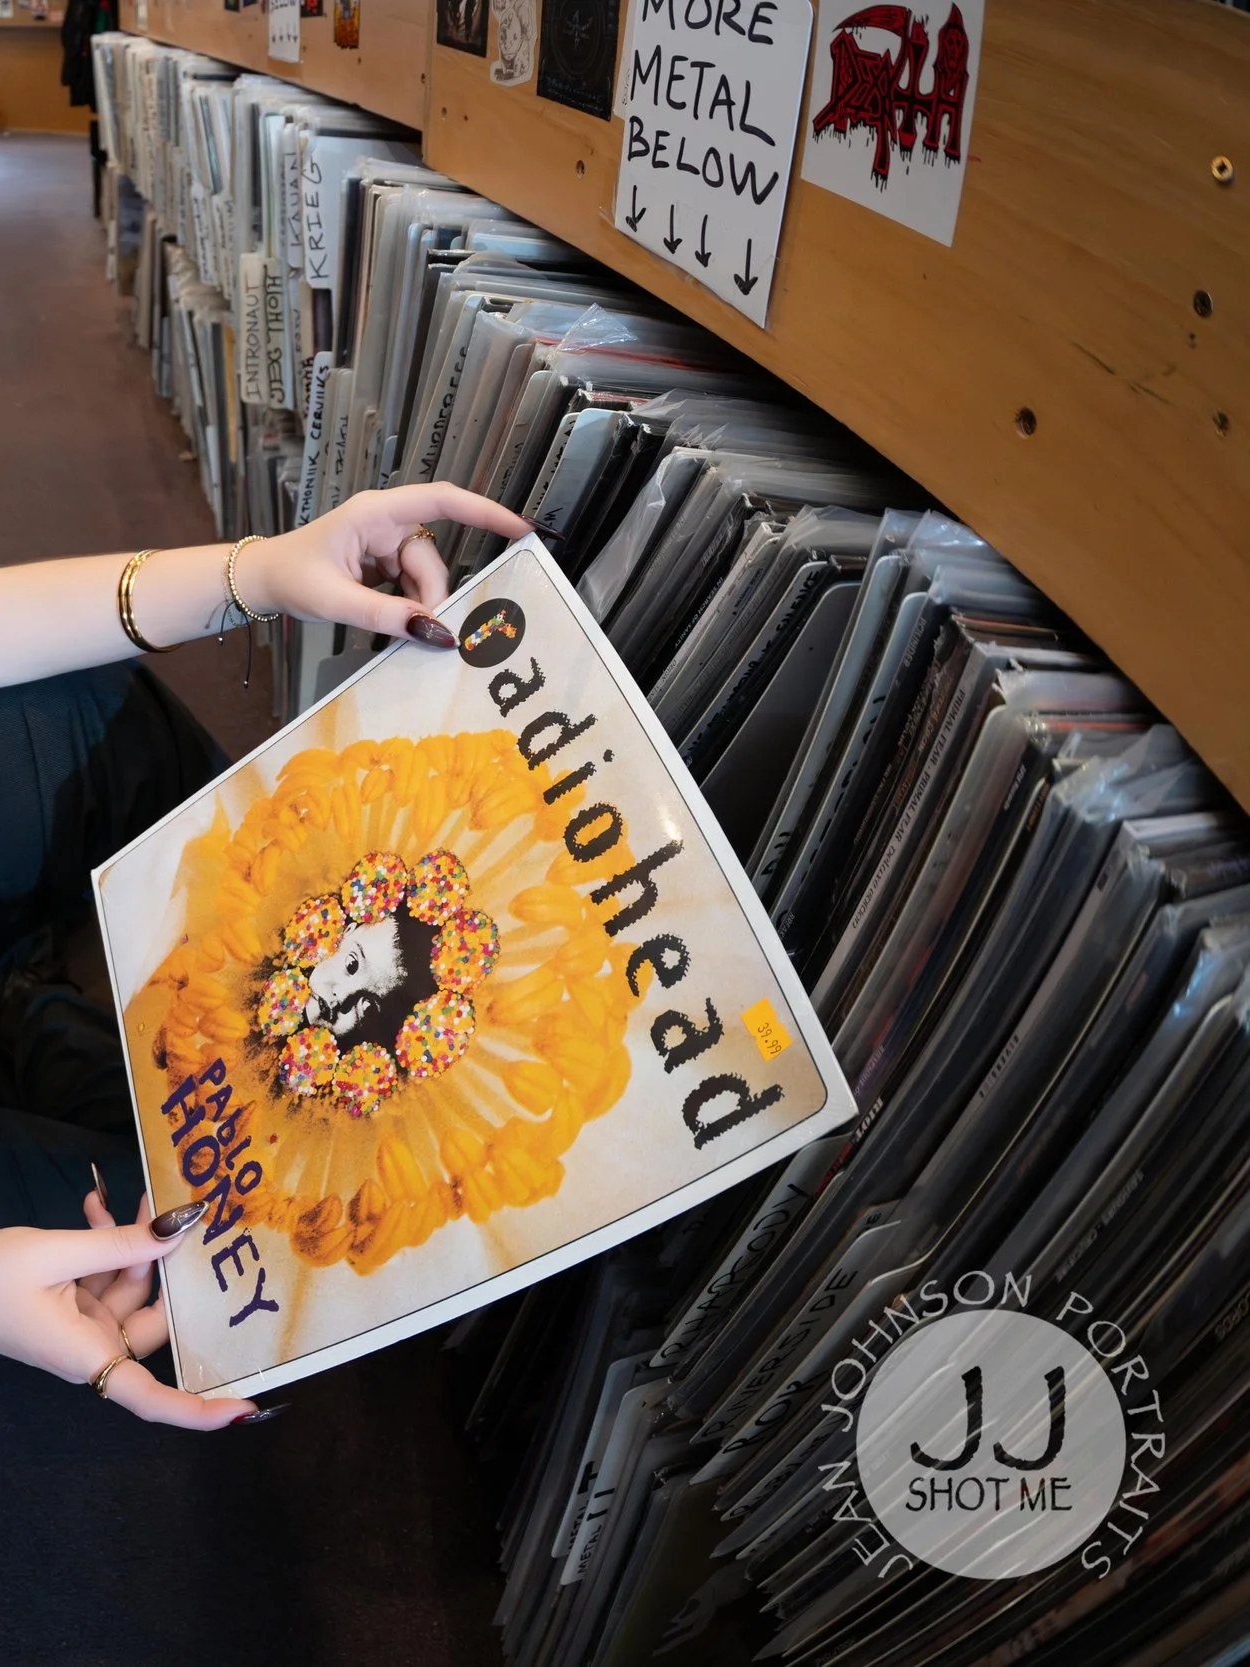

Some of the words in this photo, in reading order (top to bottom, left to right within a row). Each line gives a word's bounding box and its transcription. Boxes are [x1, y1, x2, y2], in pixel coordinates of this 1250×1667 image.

[642, 0, 779, 45] MORE
[628, 45, 777, 147] METAL
[628, 115, 780, 206] BELOW
[302, 154, 329, 280] KRIEG
[245, 271, 261, 400] INTRONAUT
[940, 688, 969, 733] PRIMAL
[906, 770, 932, 813] PRIMAL
[463, 608, 785, 1150] radiohead
[757, 1022, 782, 1054] 39.99
[161, 1075, 279, 1328] HONEY
[704, 1269, 857, 1440] RIVERSIDE
[577, 1524, 602, 1574] METAL
